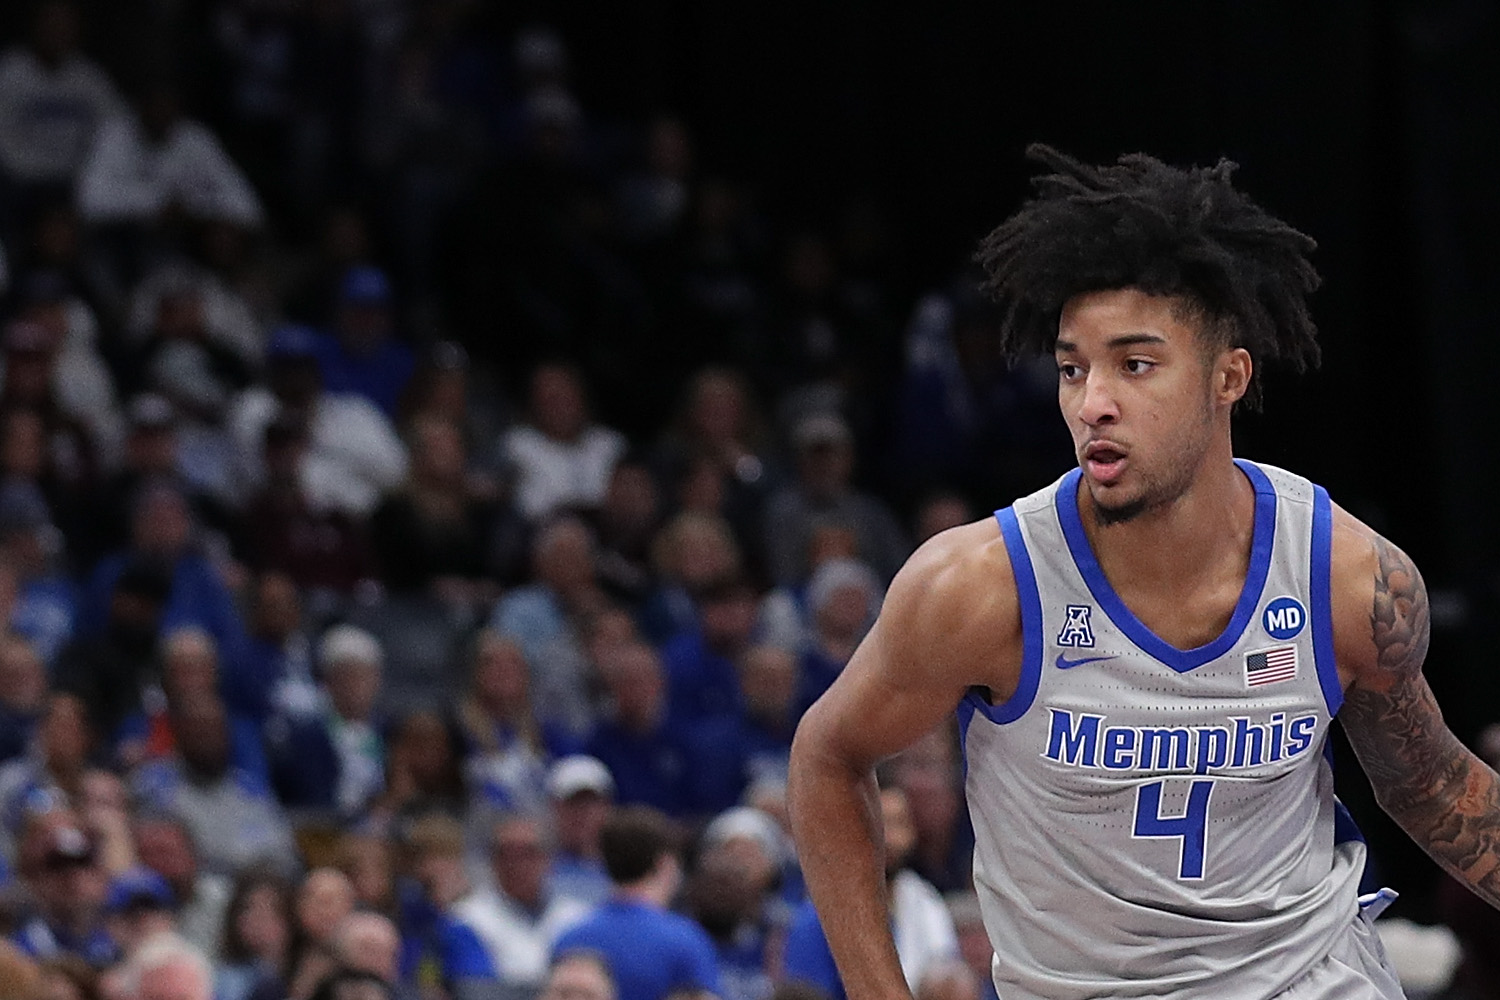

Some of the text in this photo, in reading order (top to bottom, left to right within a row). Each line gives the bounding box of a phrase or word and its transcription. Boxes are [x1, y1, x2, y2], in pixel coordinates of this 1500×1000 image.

[1267, 607, 1301, 631] MD
[1040, 708, 1317, 775] Memphis
[1131, 777, 1216, 881] 4
